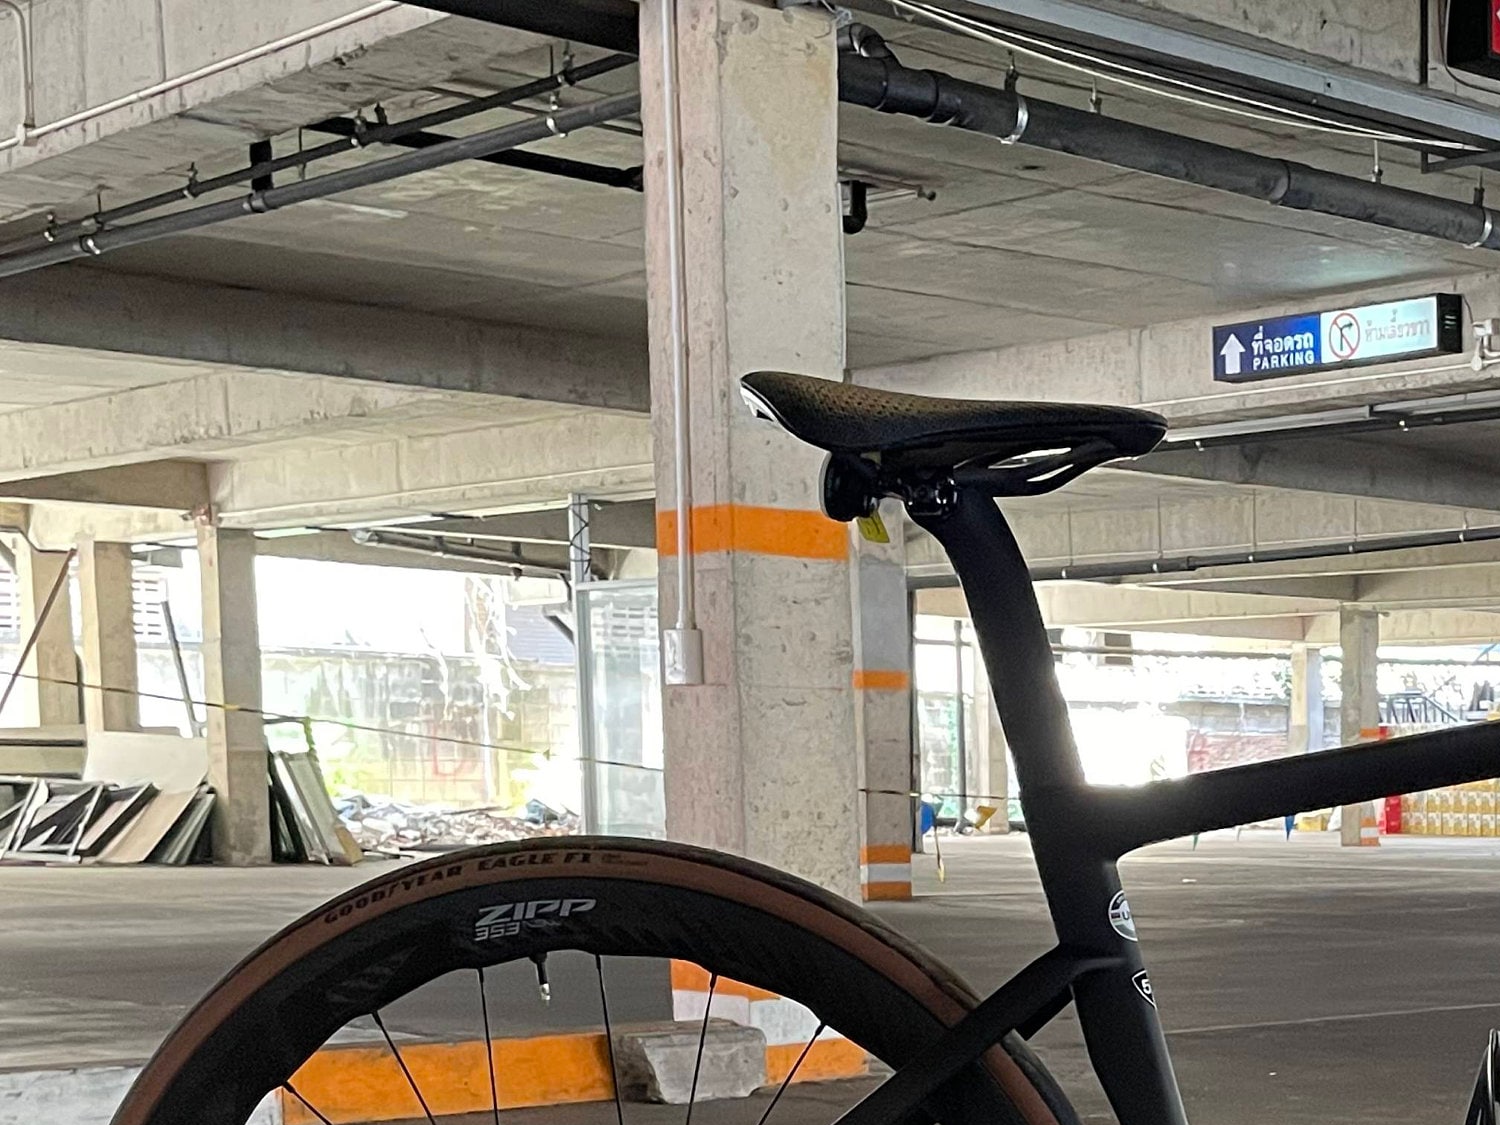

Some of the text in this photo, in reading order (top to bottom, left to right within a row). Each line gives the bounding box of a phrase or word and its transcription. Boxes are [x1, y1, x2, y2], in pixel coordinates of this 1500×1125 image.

[1251, 325, 1315, 356] ที่จอดรถ
[1252, 351, 1315, 371] PARKING
[478, 852, 555, 873] EAGLE
[475, 898, 597, 927] ZIPP
[473, 921, 521, 942] 353
